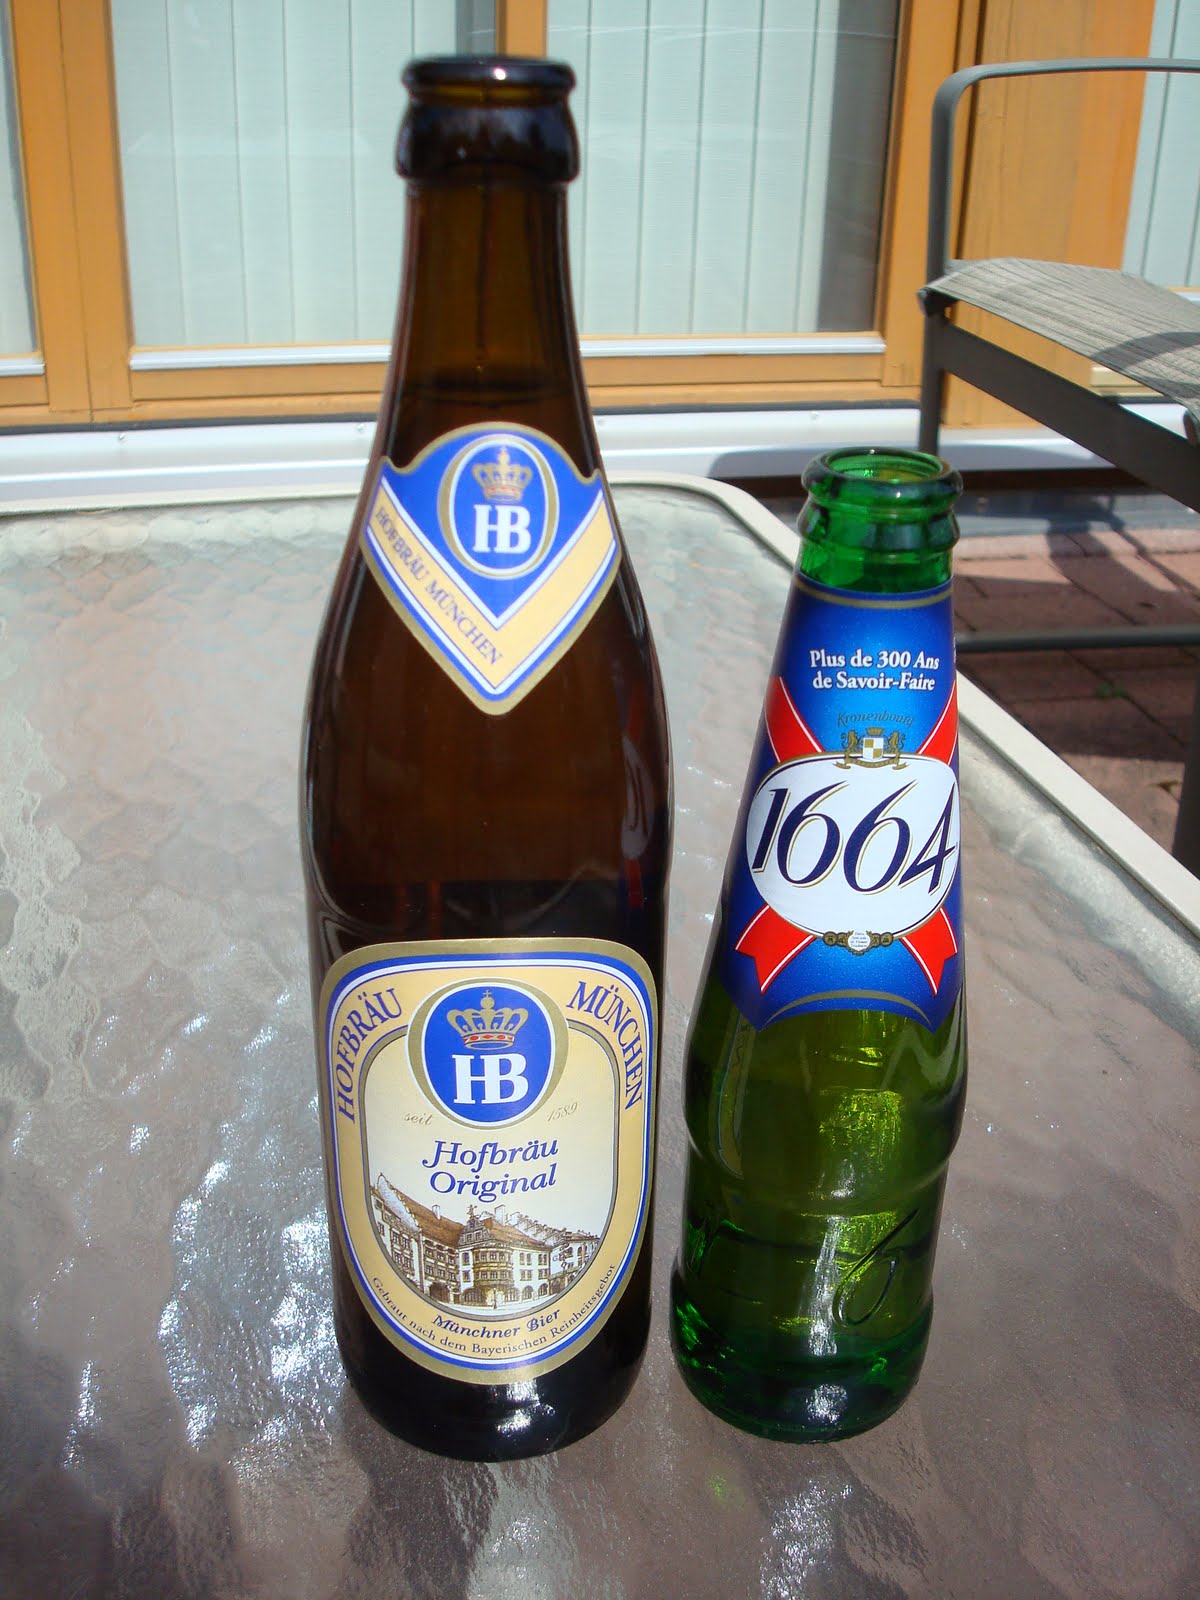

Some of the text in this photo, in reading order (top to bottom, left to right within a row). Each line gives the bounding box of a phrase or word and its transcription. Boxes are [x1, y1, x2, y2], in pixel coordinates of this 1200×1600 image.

[375, 507, 503, 664] HOFBRÄU MÜNCHEN
[810, 649, 940, 670] Plus de 300 Ans
[812, 671, 936, 691] de Savoir-Faire
[837, 709, 914, 729] Kronenbourg
[751, 779, 959, 896] 1664
[336, 981, 643, 1123] HOFBRÄU MÜNCHEN
[404, 1101, 579, 1126] seit 1589
[422, 1139, 559, 1173] Hofbräu
[430, 1163, 558, 1203] Original
[372, 1264, 616, 1357] Gebraut nach dem Bayerischen Reinheitsgebot
[431, 1308, 562, 1339] Münchner Bier
